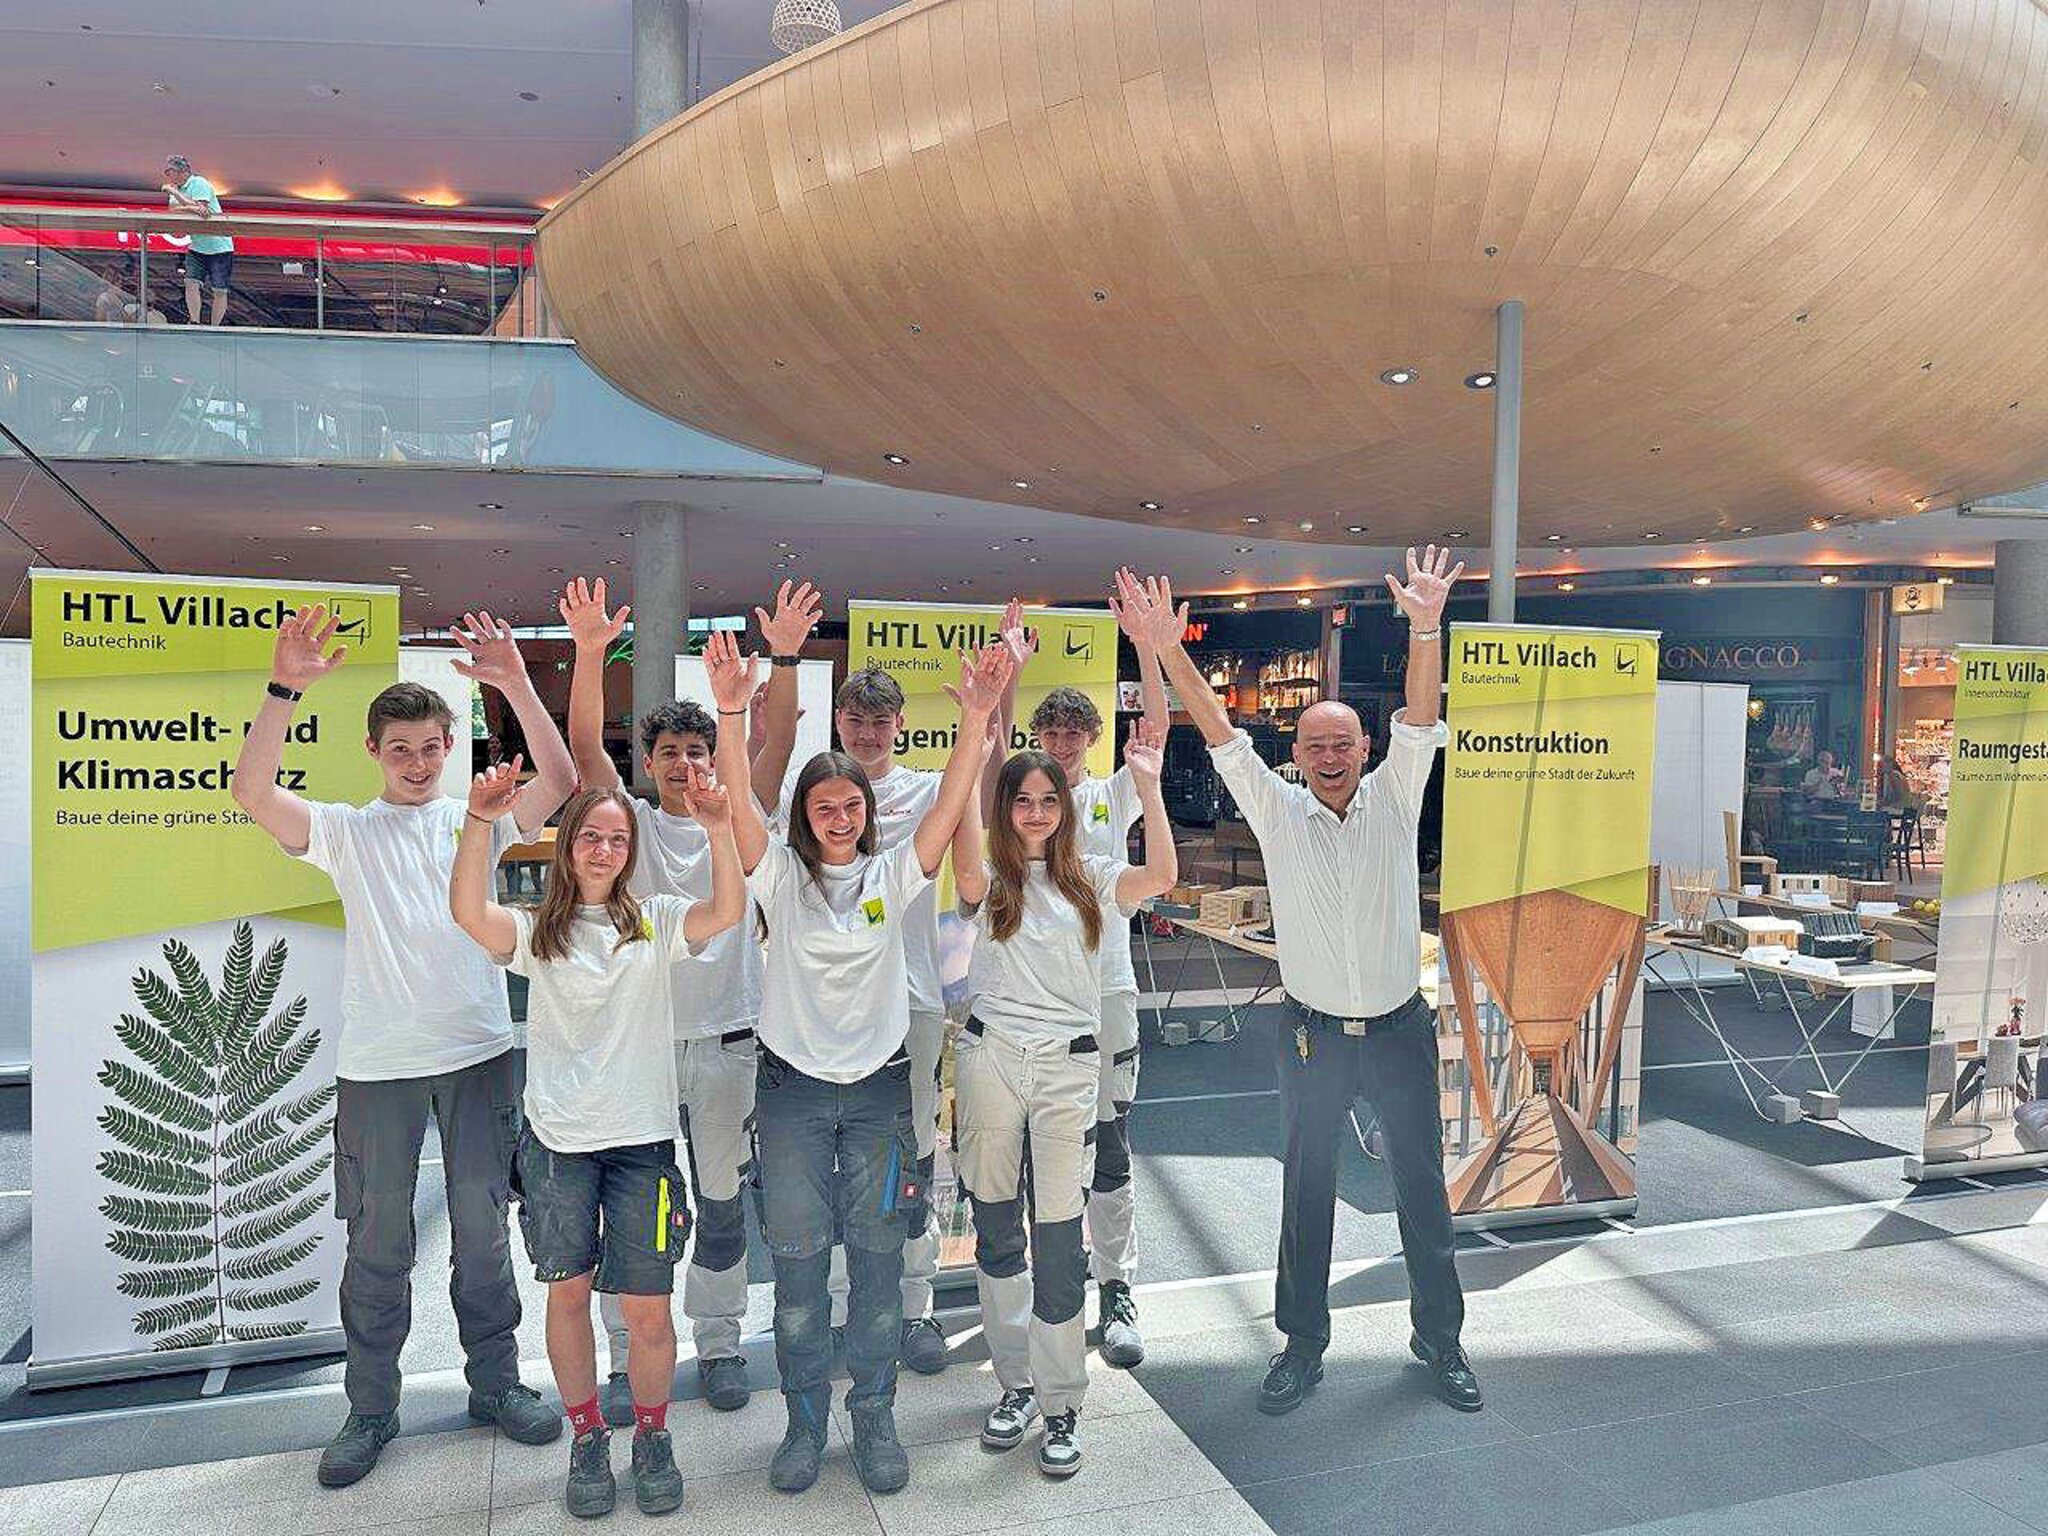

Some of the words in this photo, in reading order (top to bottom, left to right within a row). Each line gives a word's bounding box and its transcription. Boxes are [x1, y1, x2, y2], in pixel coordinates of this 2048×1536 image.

[63, 591, 146, 625] HTL
[62, 631, 167, 650] Bautechnik
[866, 621, 928, 649] HTL
[866, 655, 943, 672] Bautechnik
[1463, 642, 1509, 665] HTL
[1516, 643, 1597, 668] Villach
[1665, 646, 1800, 669] GNACCO
[1461, 672, 1521, 685] Bautechnik
[1965, 660, 2001, 681] HTL
[2006, 661, 2048, 683] Villa
[57, 711, 232, 742] Umwelt-
[1456, 729, 1609, 754] Konstruktion
[1959, 738, 2048, 764] Raumgest
[57, 759, 306, 791] Klimaschtz
[1455, 767, 1480, 778] Baue
[1549, 767, 1575, 780] Stadt
[1576, 768, 1594, 780] der
[56, 809, 102, 825] Baue
[107, 809, 159, 825] deine
[163, 810, 217, 828] grüne
